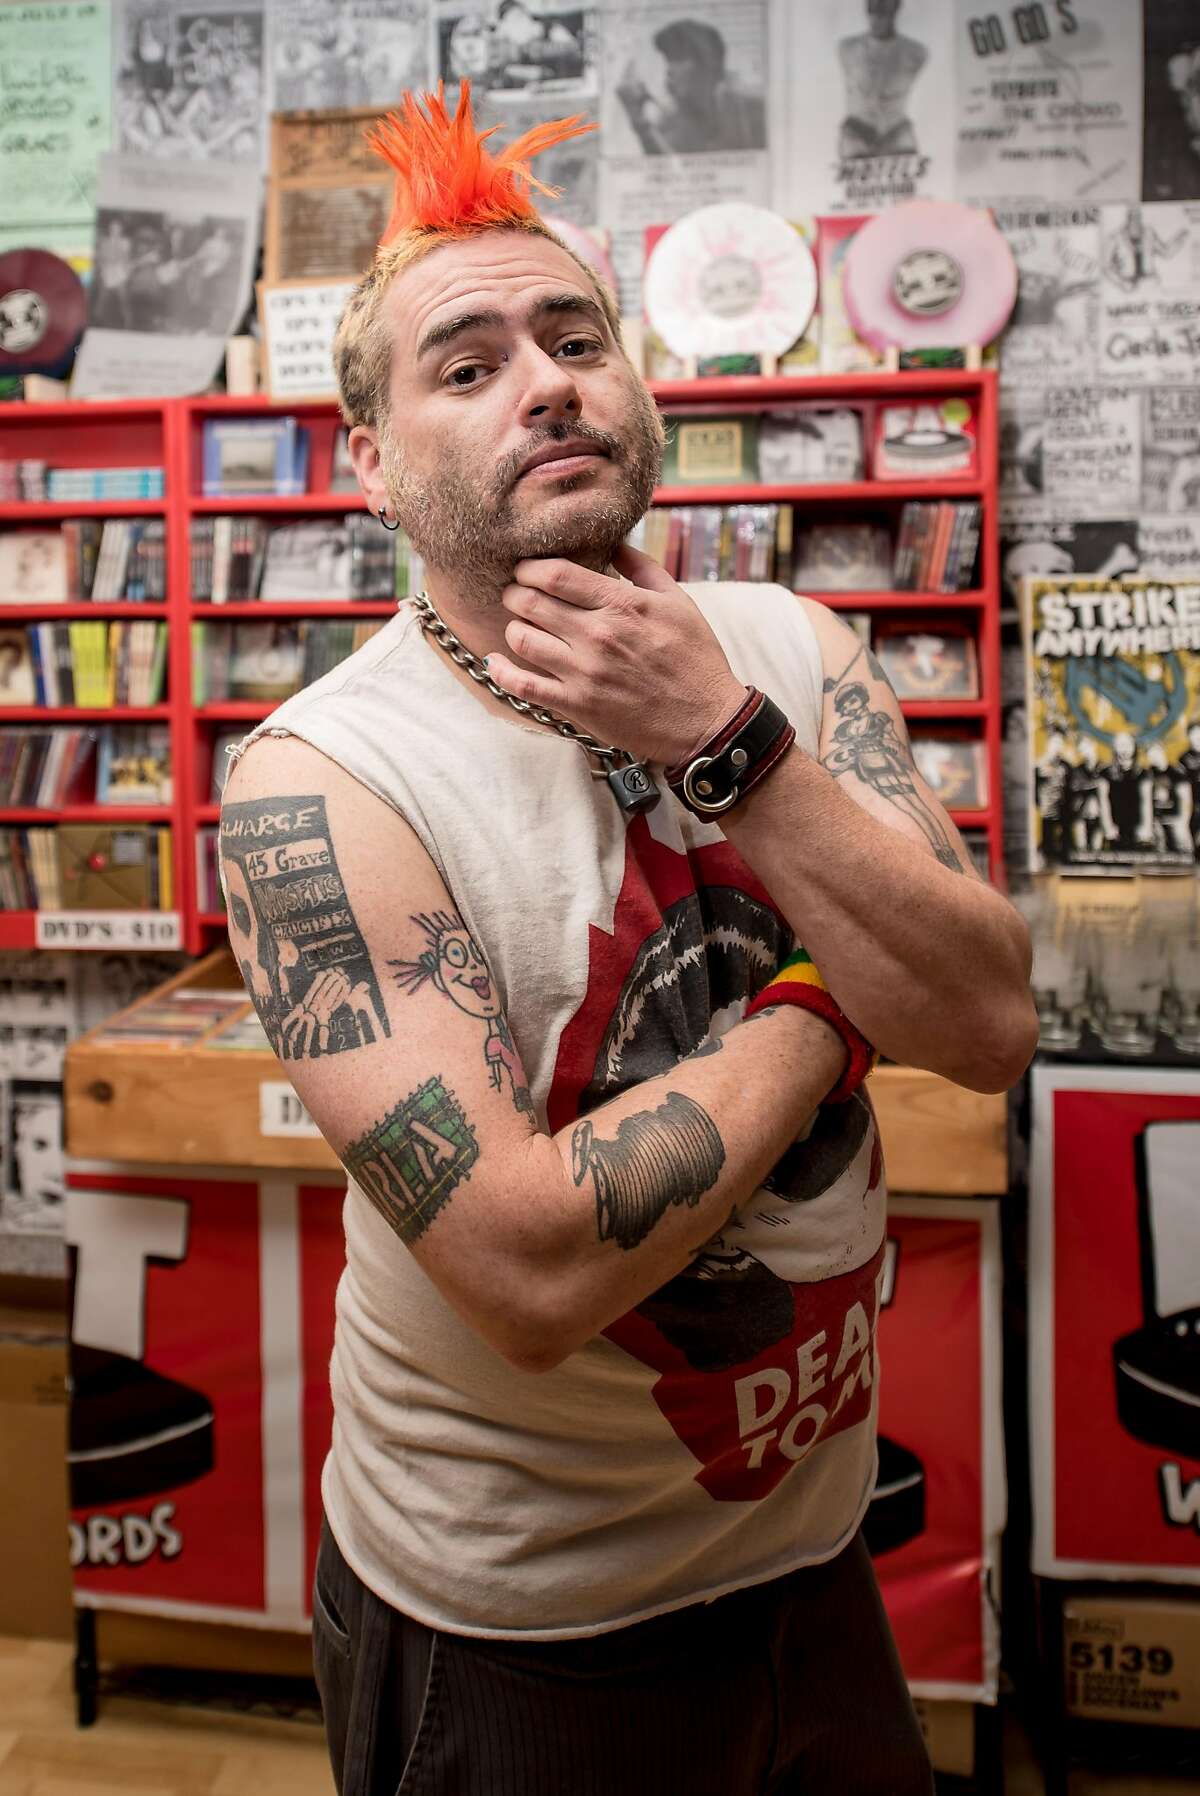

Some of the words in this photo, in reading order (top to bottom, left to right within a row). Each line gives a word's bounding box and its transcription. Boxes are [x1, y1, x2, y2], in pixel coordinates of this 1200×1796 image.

[968, 14, 1007, 57] GO
[1040, 586, 1200, 631] STRIKE
[249, 853, 269, 876] 45
[275, 849, 330, 873] Grave
[42, 921, 112, 939] DVD'S
[131, 920, 174, 939] $10
[741, 1403, 829, 1468] TO
[1069, 1641, 1175, 1676] 5139
